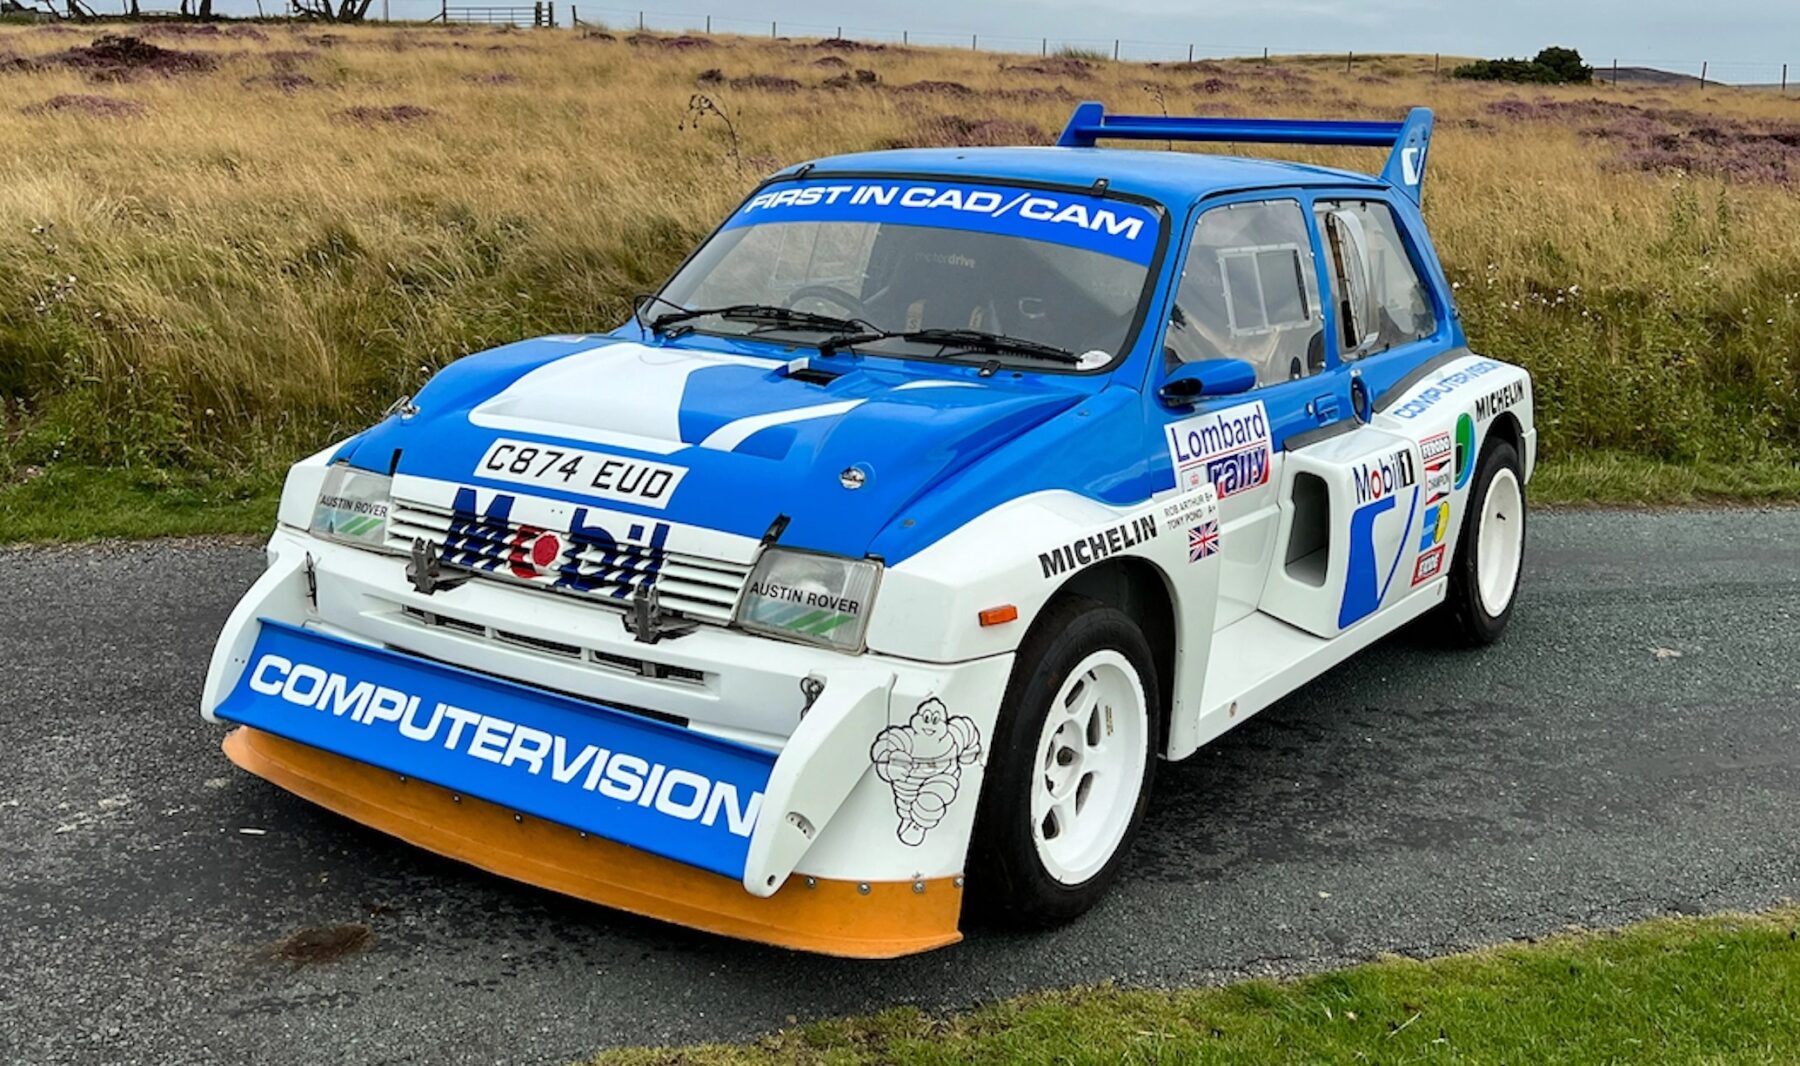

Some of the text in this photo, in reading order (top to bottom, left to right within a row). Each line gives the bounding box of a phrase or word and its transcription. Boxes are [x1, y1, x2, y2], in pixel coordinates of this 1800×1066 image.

[745, 186, 1144, 240] FIRST IN CAD/CAM
[1475, 379, 1524, 422] MICHELIN
[1171, 404, 1266, 463] Lombard
[487, 444, 673, 500] C874 EUD
[1211, 448, 1267, 496] rally
[1352, 454, 1402, 505] Mobil
[319, 493, 388, 519] AUSTIN ROVER
[1038, 514, 1158, 579] MICHELIN
[750, 581, 860, 615] AUSTIN ROVER
[249, 654, 766, 838] COMPUTERVISION
